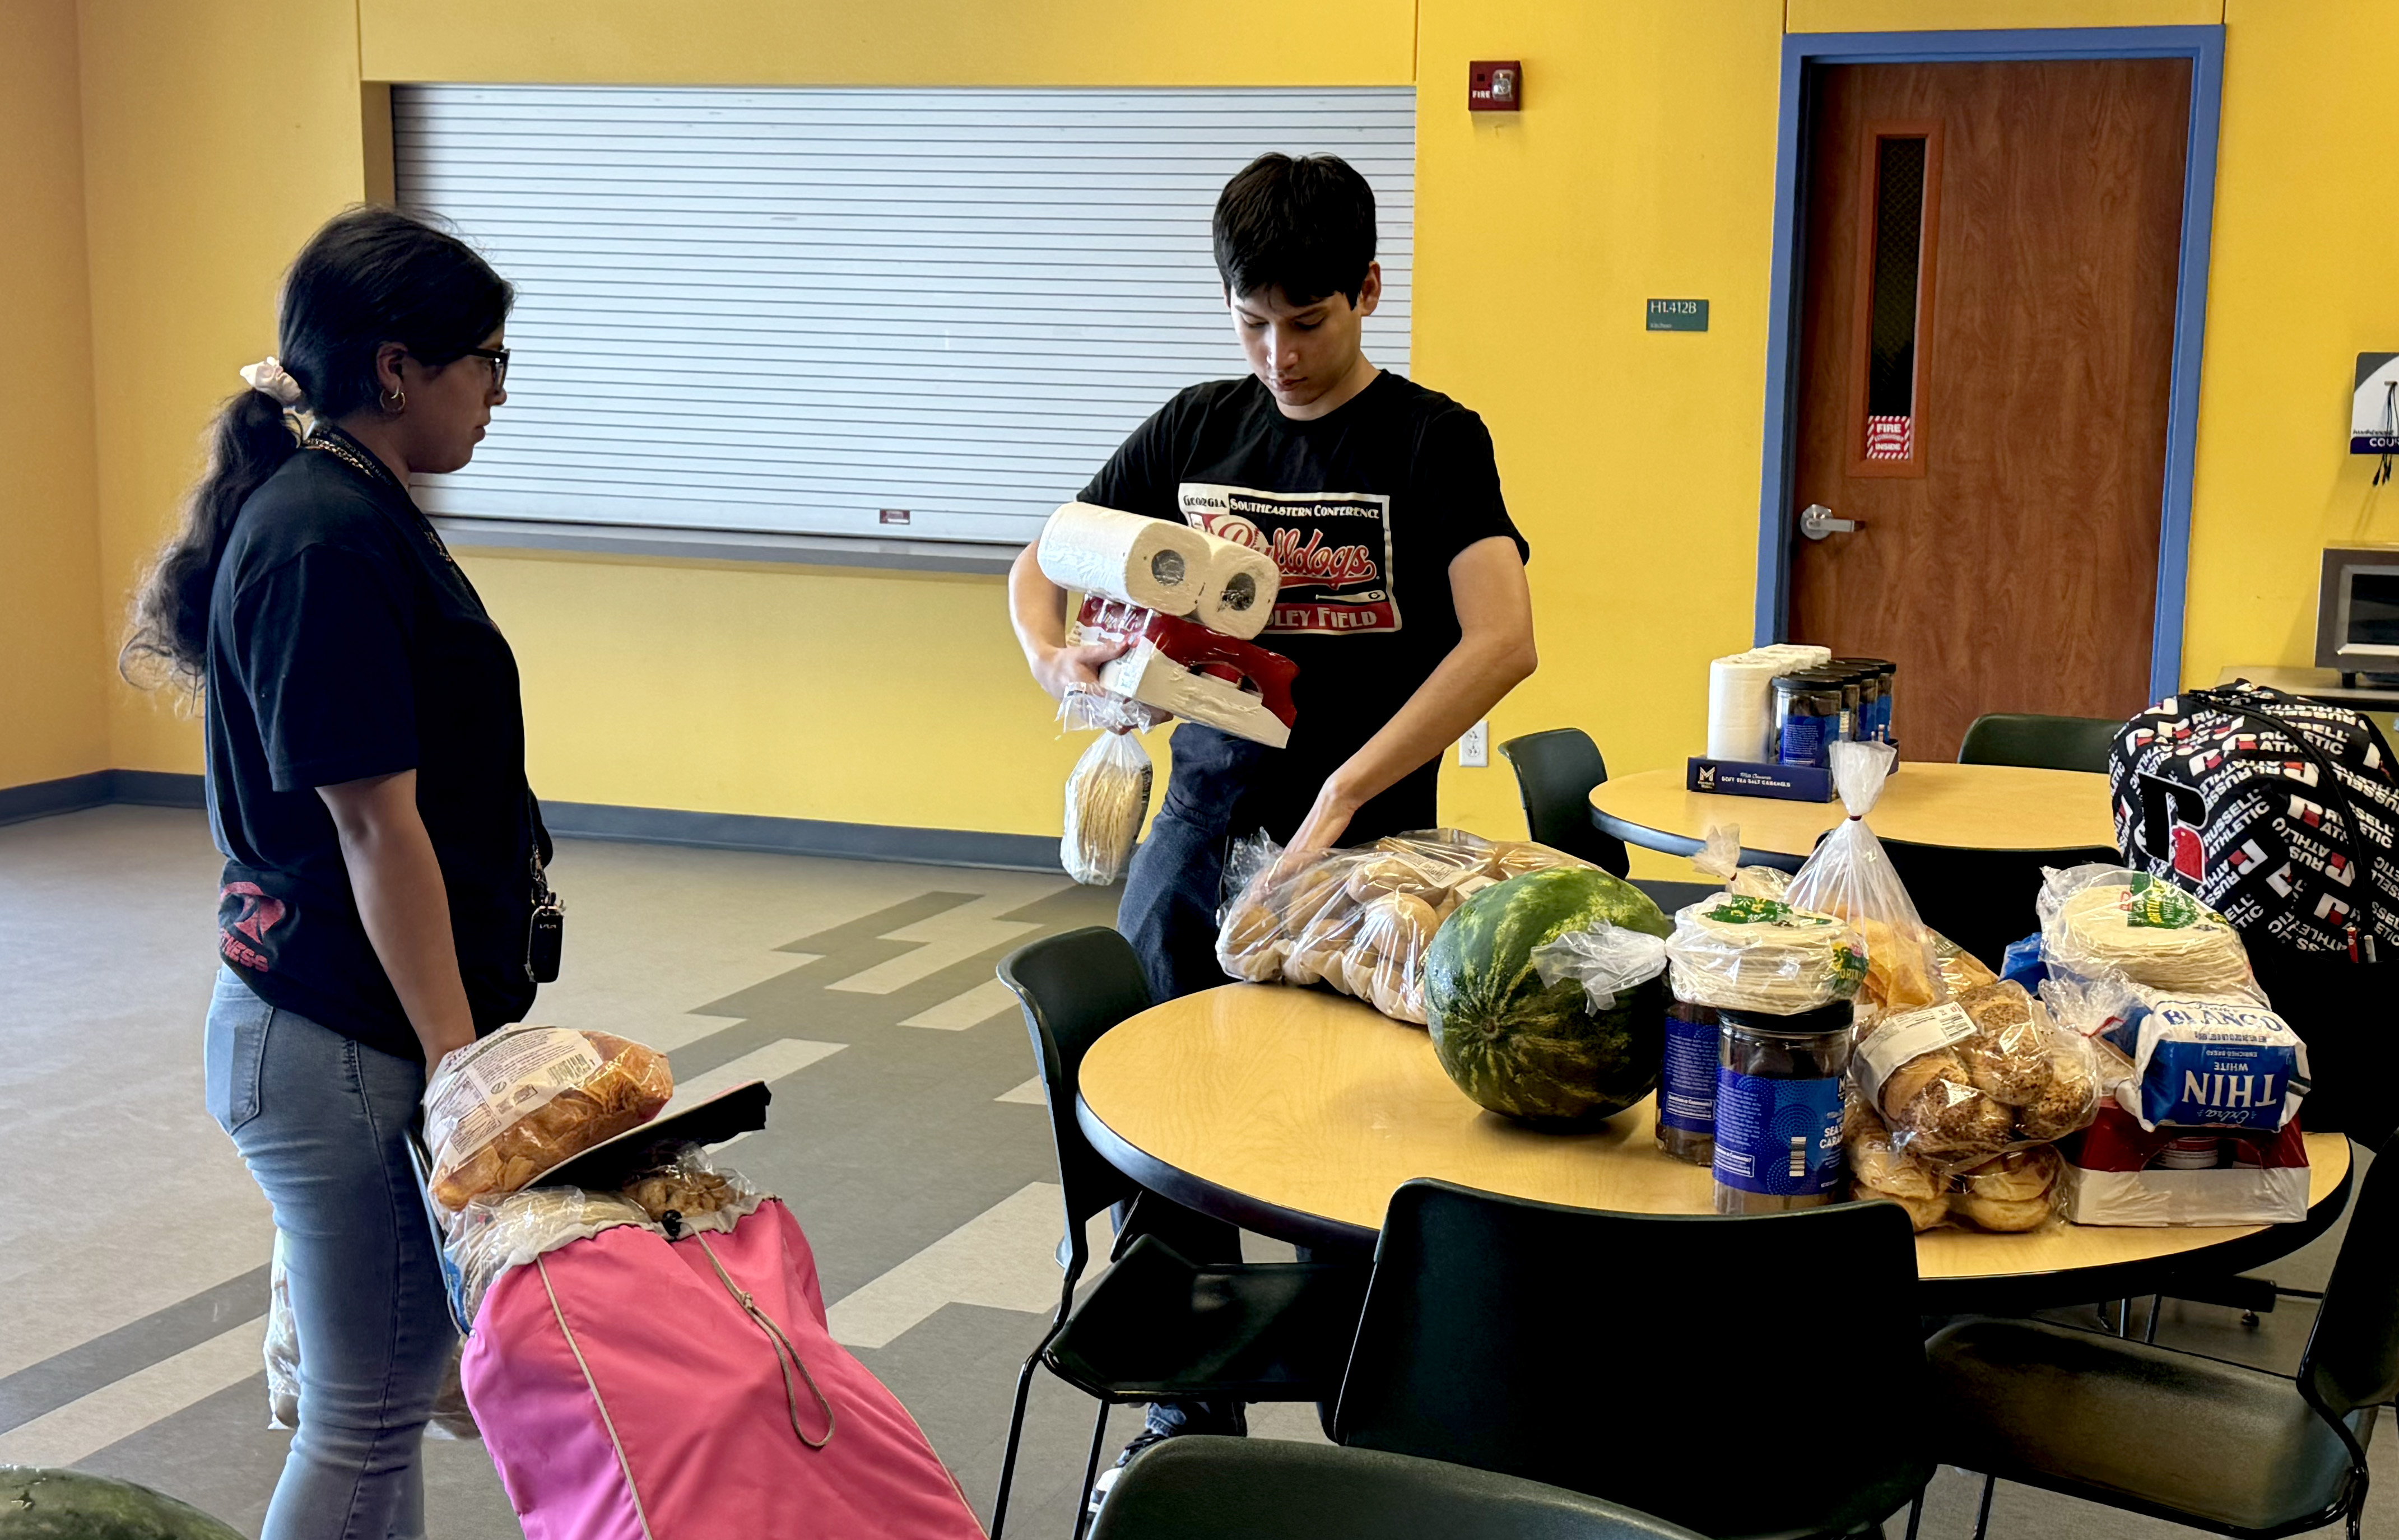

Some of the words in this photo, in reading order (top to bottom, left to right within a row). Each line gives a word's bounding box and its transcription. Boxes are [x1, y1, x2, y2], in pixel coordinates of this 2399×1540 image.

[1876, 424, 1901, 433] FIRE
[1230, 498, 1312, 517] SOUTHEASTERN
[1314, 505, 1380, 519] CONFERENCE
[1267, 608, 1310, 626] LEY
[1317, 607, 1377, 628] FIELD
[2203, 792, 2262, 847] RUSSELL
[2209, 801, 2270, 859] ATHLETIC
[2193, 859, 2230, 899] ATHLE
[2163, 896, 2175, 919] WHITE
[2214, 1062, 2248, 1072] WHITE
[2181, 1069, 2277, 1108] THIN
